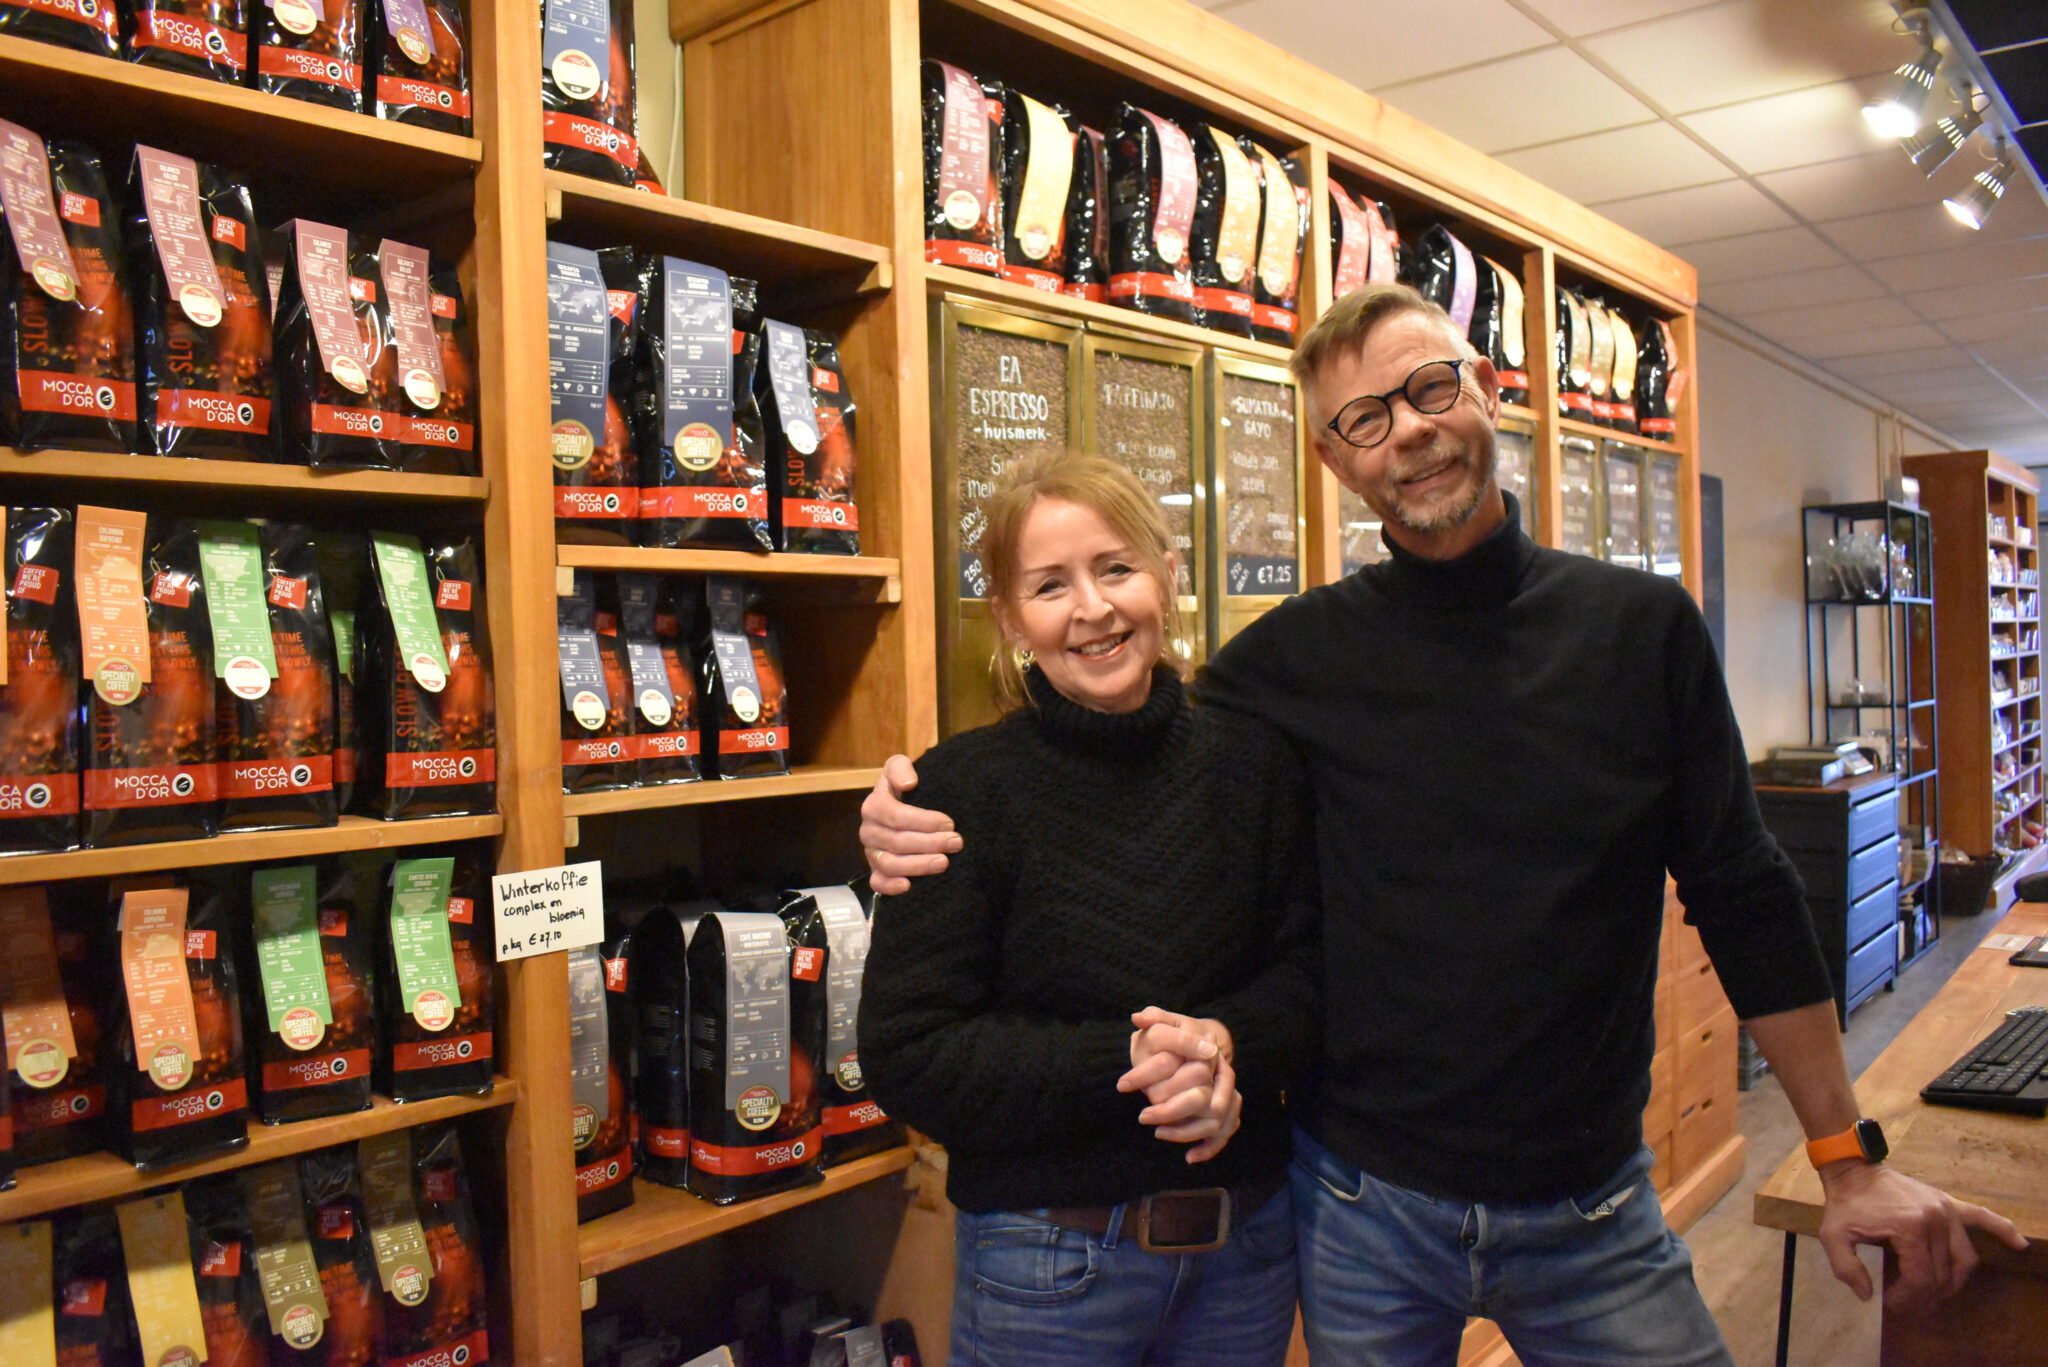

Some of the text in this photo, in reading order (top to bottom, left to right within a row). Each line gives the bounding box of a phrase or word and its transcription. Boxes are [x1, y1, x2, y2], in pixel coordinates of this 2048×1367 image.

[153, 18, 202, 38] MOCCA
[170, 31, 203, 49] D'OR
[286, 54, 324, 68] MOCCA
[301, 63, 324, 78] D'OR
[401, 83, 436, 96] MOCCA
[415, 92, 436, 105] D'OR
[64, 194, 86, 205] COFFEE
[64, 205, 84, 215] PROUD
[217, 218, 236, 228] COFFEE
[216, 228, 235, 237] PROUD
[1000, 355, 1022, 384] EA
[42, 380, 93, 395] MOCCA
[63, 394, 94, 408] D'OR
[188, 398, 235, 412] MOCCA
[970, 388, 1048, 421] ESPRESSO
[207, 411, 235, 424] D'OR
[334, 411, 368, 422] MOCCA
[347, 422, 368, 432] D'OR
[412, 422, 444, 433] MOCCA
[1244, 420, 1271, 438] GAYO
[425, 431, 445, 441] D'OR
[564, 493, 602, 503] MOCCA
[694, 493, 731, 502] MOCCA
[578, 502, 602, 512] D'OR
[708, 502, 731, 511] D'OR
[801, 505, 832, 515] MOCCA
[814, 514, 833, 524] D'OR
[22, 567, 46, 577] COFFEE
[964, 559, 982, 583] 250
[1257, 566, 1292, 584] €7.25
[20, 580, 41, 590] PROUD
[276, 578, 296, 587] COFFEE
[274, 589, 293, 598] PROUD
[101, 672, 135, 681] SPECIALTY
[106, 681, 130, 690] COFFEE
[648, 737, 675, 745] MOCCA
[738, 733, 765, 741] MOCCA
[579, 744, 607, 752] MOCCA
[413, 758, 456, 769] MOCCA
[235, 766, 288, 780] MOCCA
[429, 768, 457, 779] D'OR
[115, 774, 169, 788] MOCCA
[255, 776, 288, 790] D'OR
[136, 787, 169, 800] D'OR
[500, 871, 588, 901] Winterkoffie
[504, 900, 546, 917] complex
[285, 1017, 317, 1028] SPECIALTY
[292, 1026, 313, 1036] COFFEE
[418, 1044, 455, 1054] MOCCA
[154, 1054, 186, 1067] SPECIALTY
[432, 1051, 455, 1062] D'OR
[161, 1064, 182, 1076] COFFEE
[289, 1061, 328, 1073] MOCCA
[304, 1069, 328, 1080] D'OR
[162, 1096, 204, 1111] MOCCA
[742, 1096, 774, 1108] SPECIALTY
[178, 1105, 204, 1118] D'OR
[747, 1106, 769, 1116] COFFEE
[860, 1112, 879, 1123] D'OR
[756, 1147, 790, 1160] MOCCA
[768, 1155, 790, 1166] D'OR
[576, 1166, 605, 1181] MOCCA
[586, 1175, 606, 1188] D'OR
[396, 1274, 422, 1288] SPECIALTY
[402, 1283, 421, 1294] COFFEE
[286, 1314, 315, 1330] SPECIALTY
[293, 1324, 313, 1337] COFFEE
